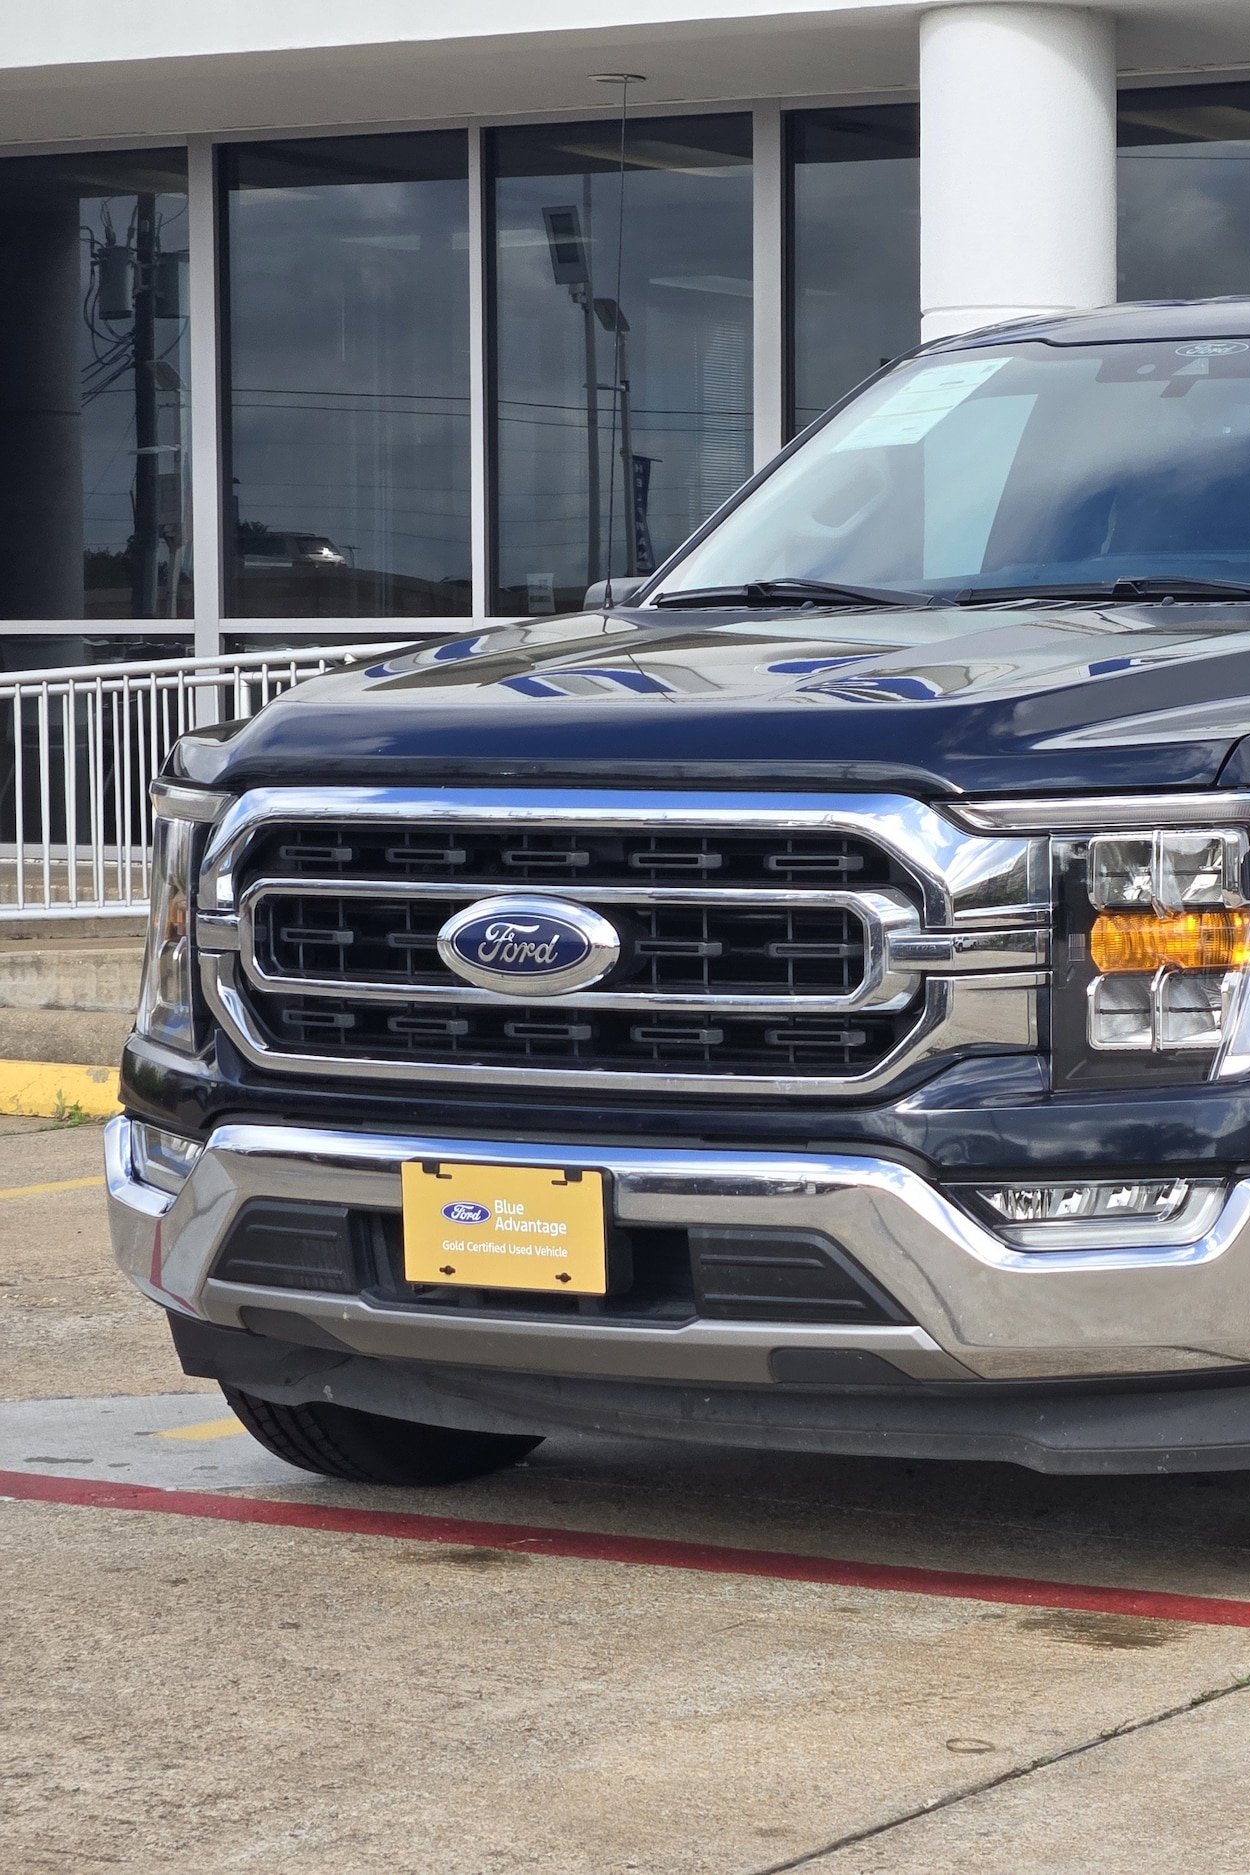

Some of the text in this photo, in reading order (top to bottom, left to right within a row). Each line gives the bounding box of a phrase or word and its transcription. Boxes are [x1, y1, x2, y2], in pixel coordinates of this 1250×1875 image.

[477, 922, 561, 964] Ford
[450, 1204, 482, 1221] Ford
[494, 1199, 525, 1215] Blue
[495, 1216, 567, 1237] Advantage
[442, 1240, 568, 1258] Gold Certified Used Vehicle
